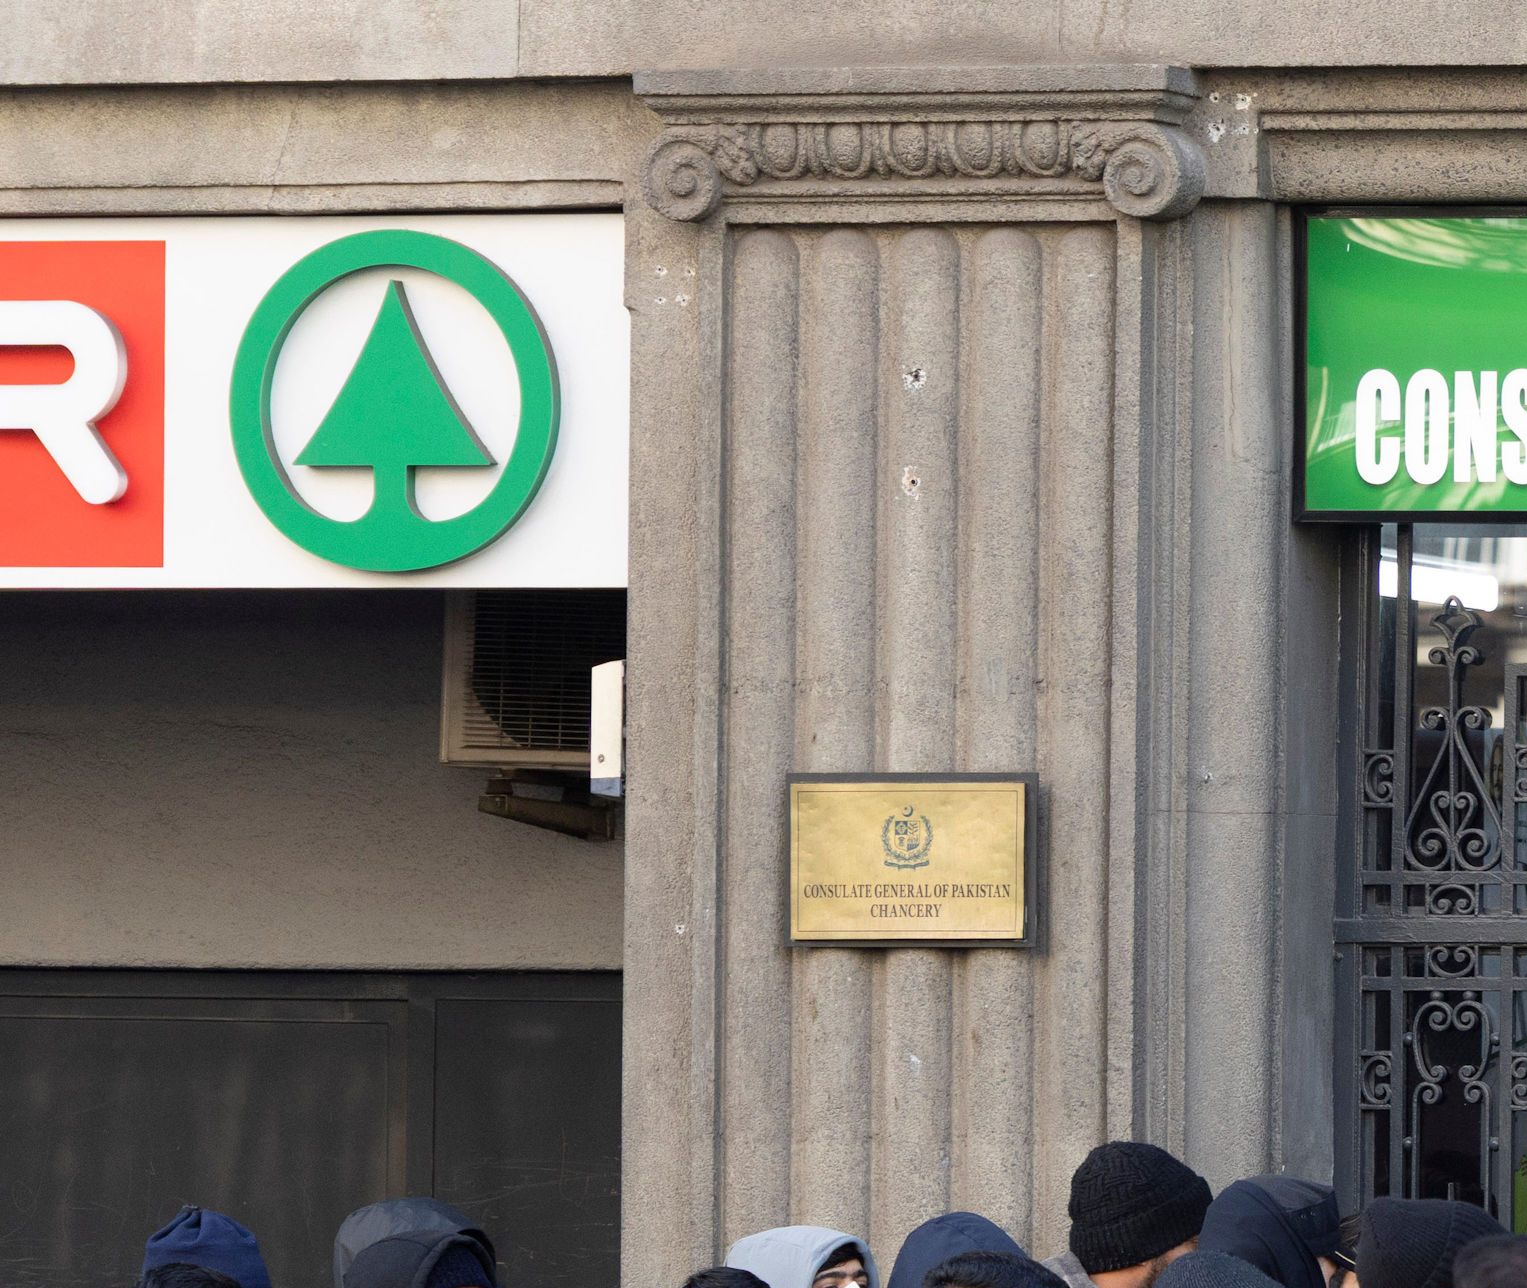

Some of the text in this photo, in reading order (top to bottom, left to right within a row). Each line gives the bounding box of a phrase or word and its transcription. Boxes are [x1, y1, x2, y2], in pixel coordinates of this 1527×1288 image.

[803, 884, 1011, 898] CONSULATE GENERAL OF PAKISTAN
[870, 904, 942, 918] CHANCERY
